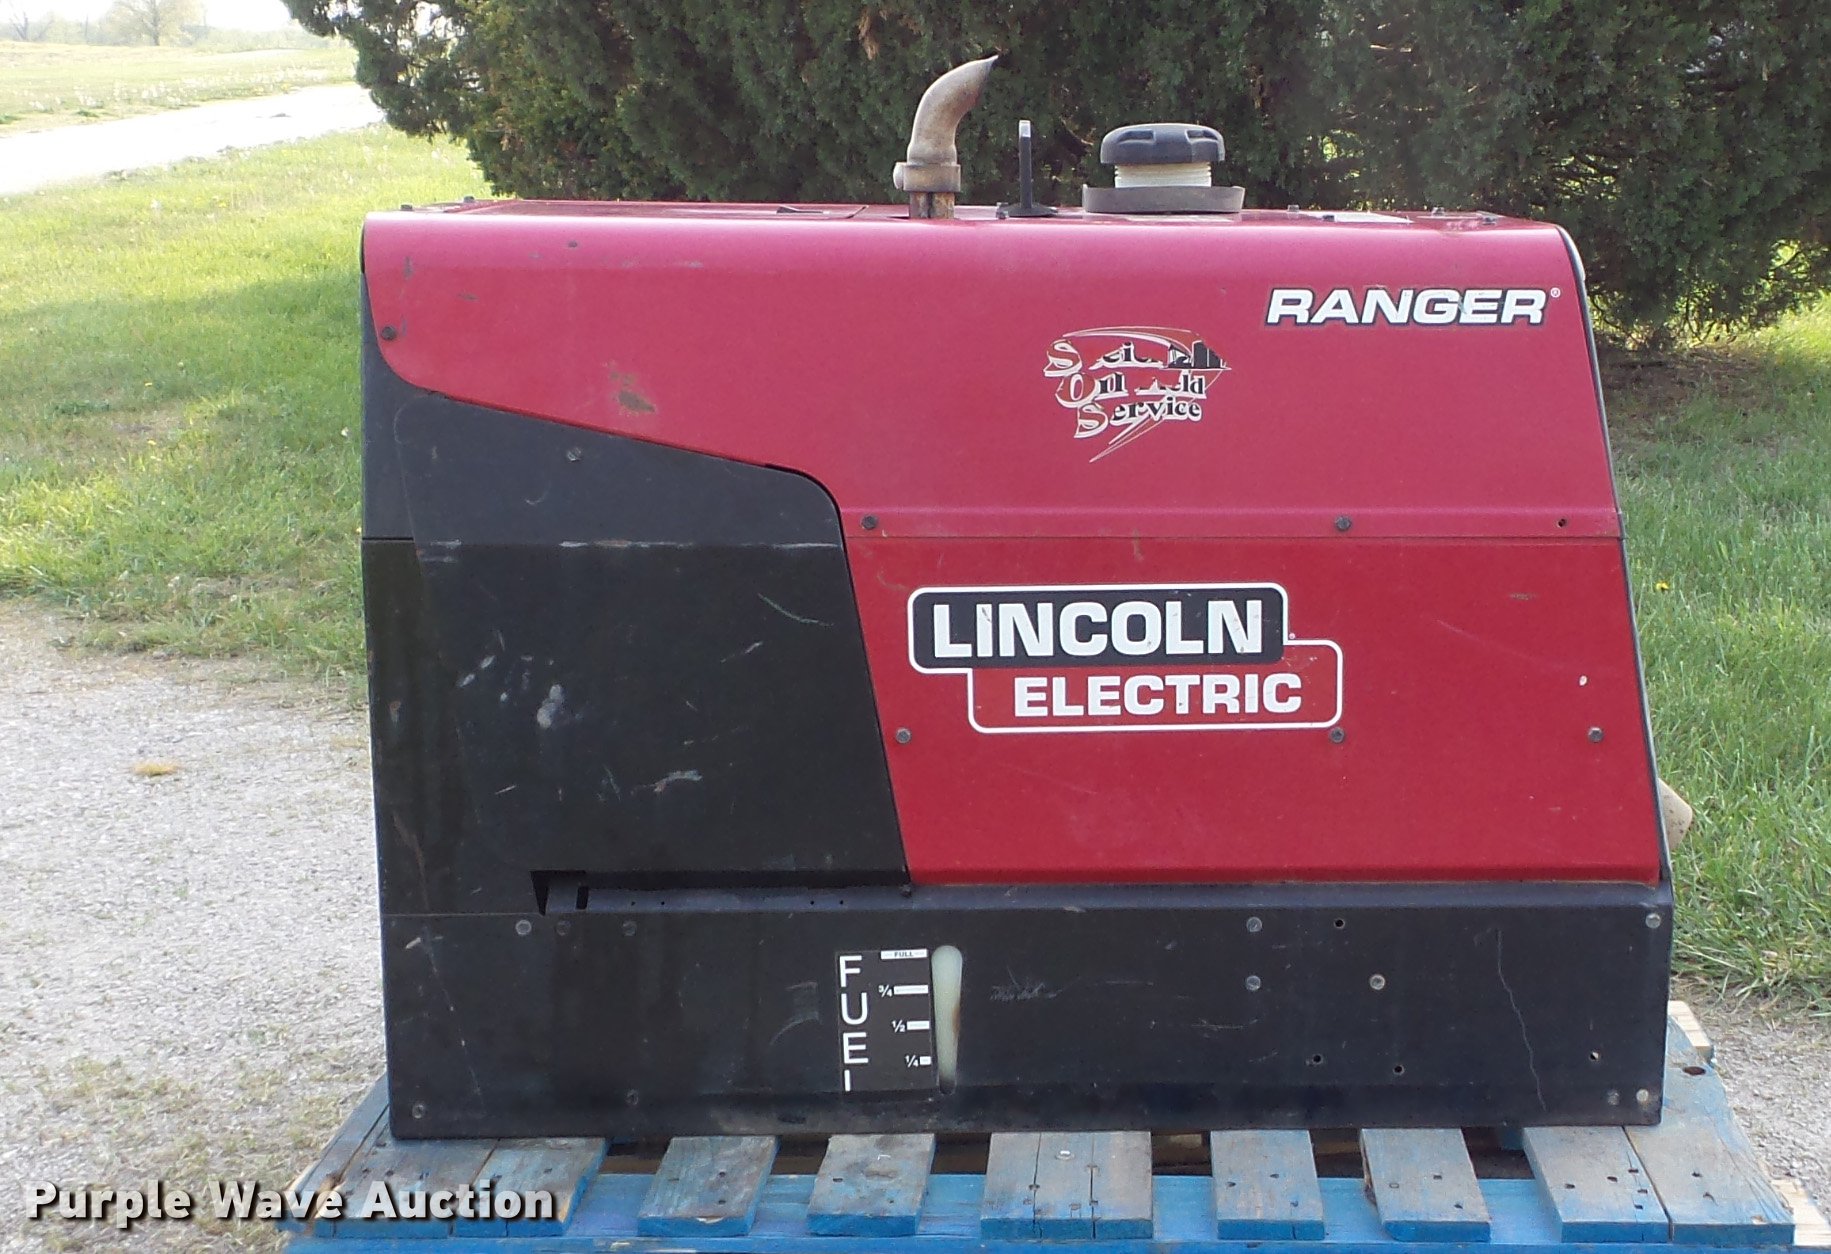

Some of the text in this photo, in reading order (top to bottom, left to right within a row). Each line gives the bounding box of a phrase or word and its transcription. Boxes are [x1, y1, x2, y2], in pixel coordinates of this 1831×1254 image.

[1266, 288, 1547, 326] RANGER
[1074, 396, 1202, 438] Service
[933, 600, 1263, 658] LINCOLN
[1014, 673, 1302, 717] ELECTRIC
